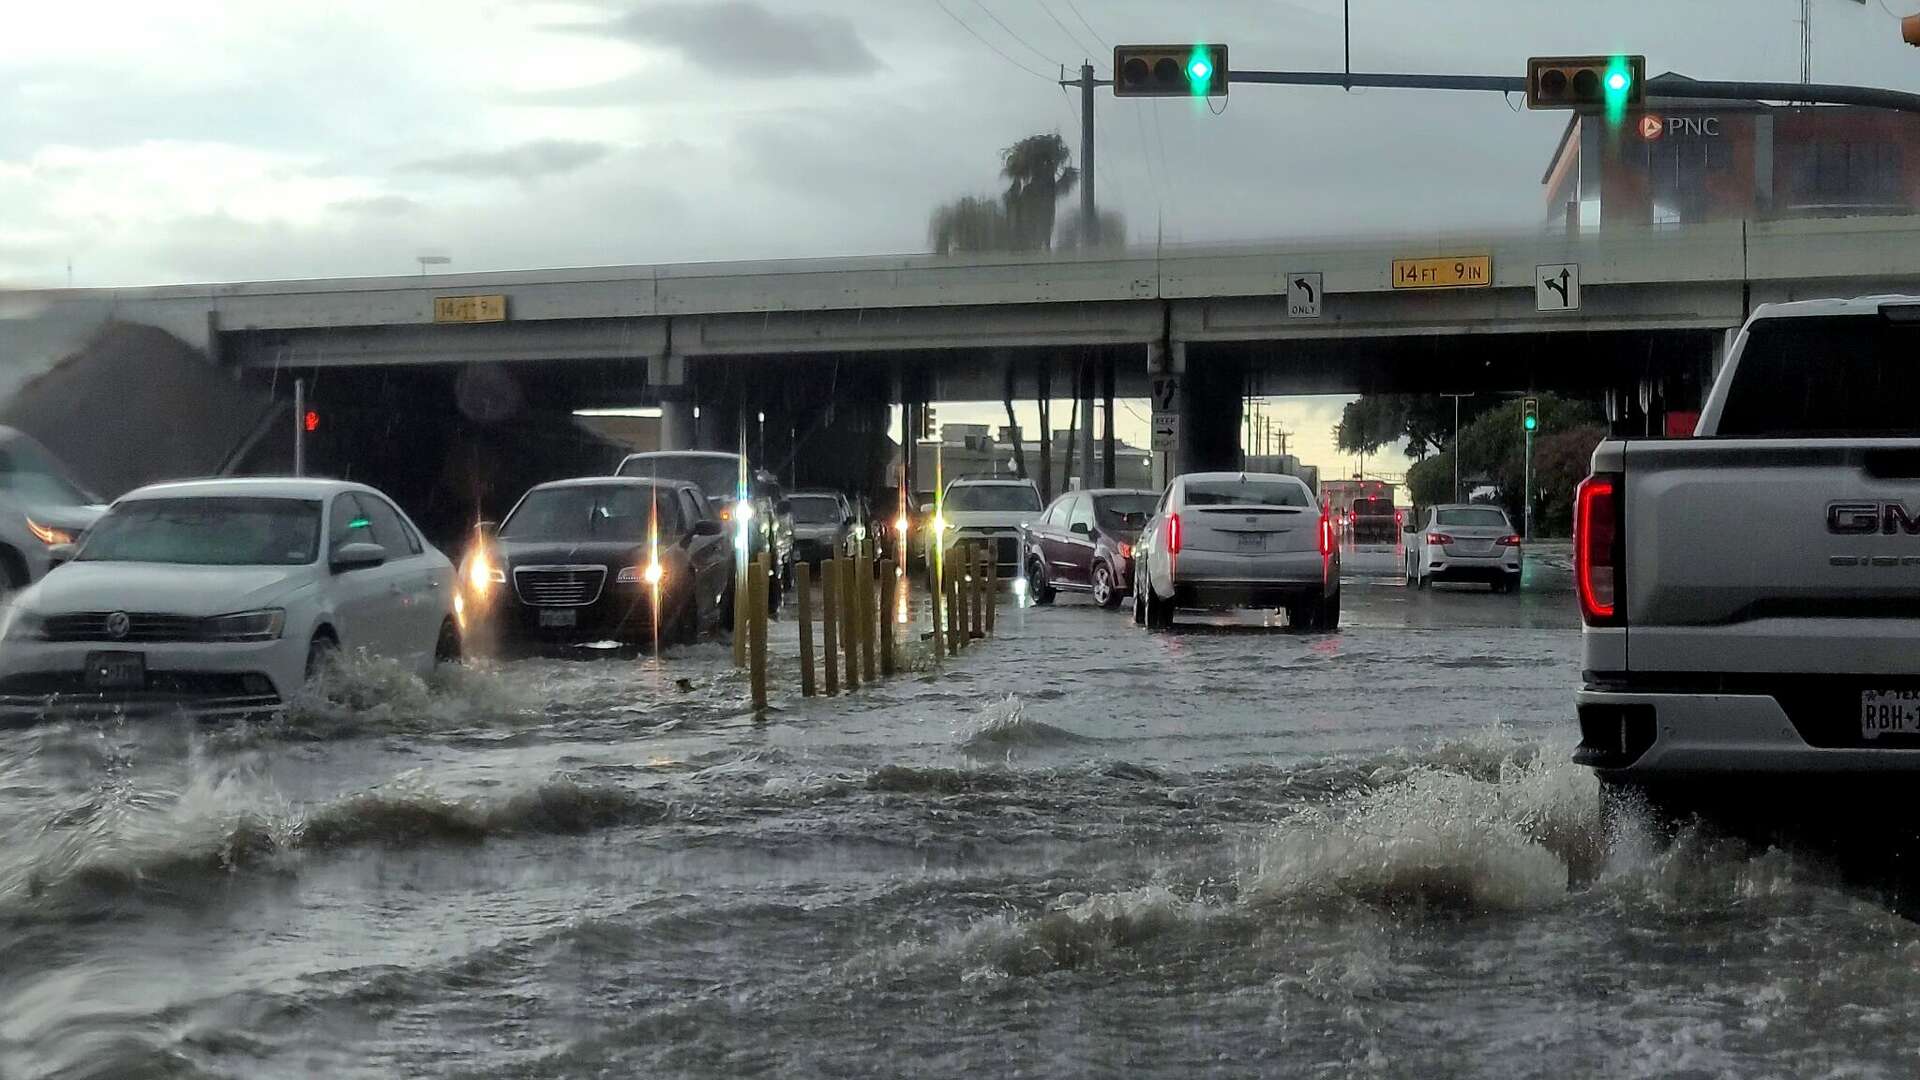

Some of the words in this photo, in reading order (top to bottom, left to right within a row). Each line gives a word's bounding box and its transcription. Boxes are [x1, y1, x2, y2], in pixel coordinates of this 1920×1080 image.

[1667, 117, 1719, 136] PNC
[1400, 265, 1418, 282] 14
[1422, 268, 1437, 281] FT
[1455, 263, 1464, 279] 9
[1469, 267, 1481, 279] IN
[1292, 305, 1315, 315] ONLY
